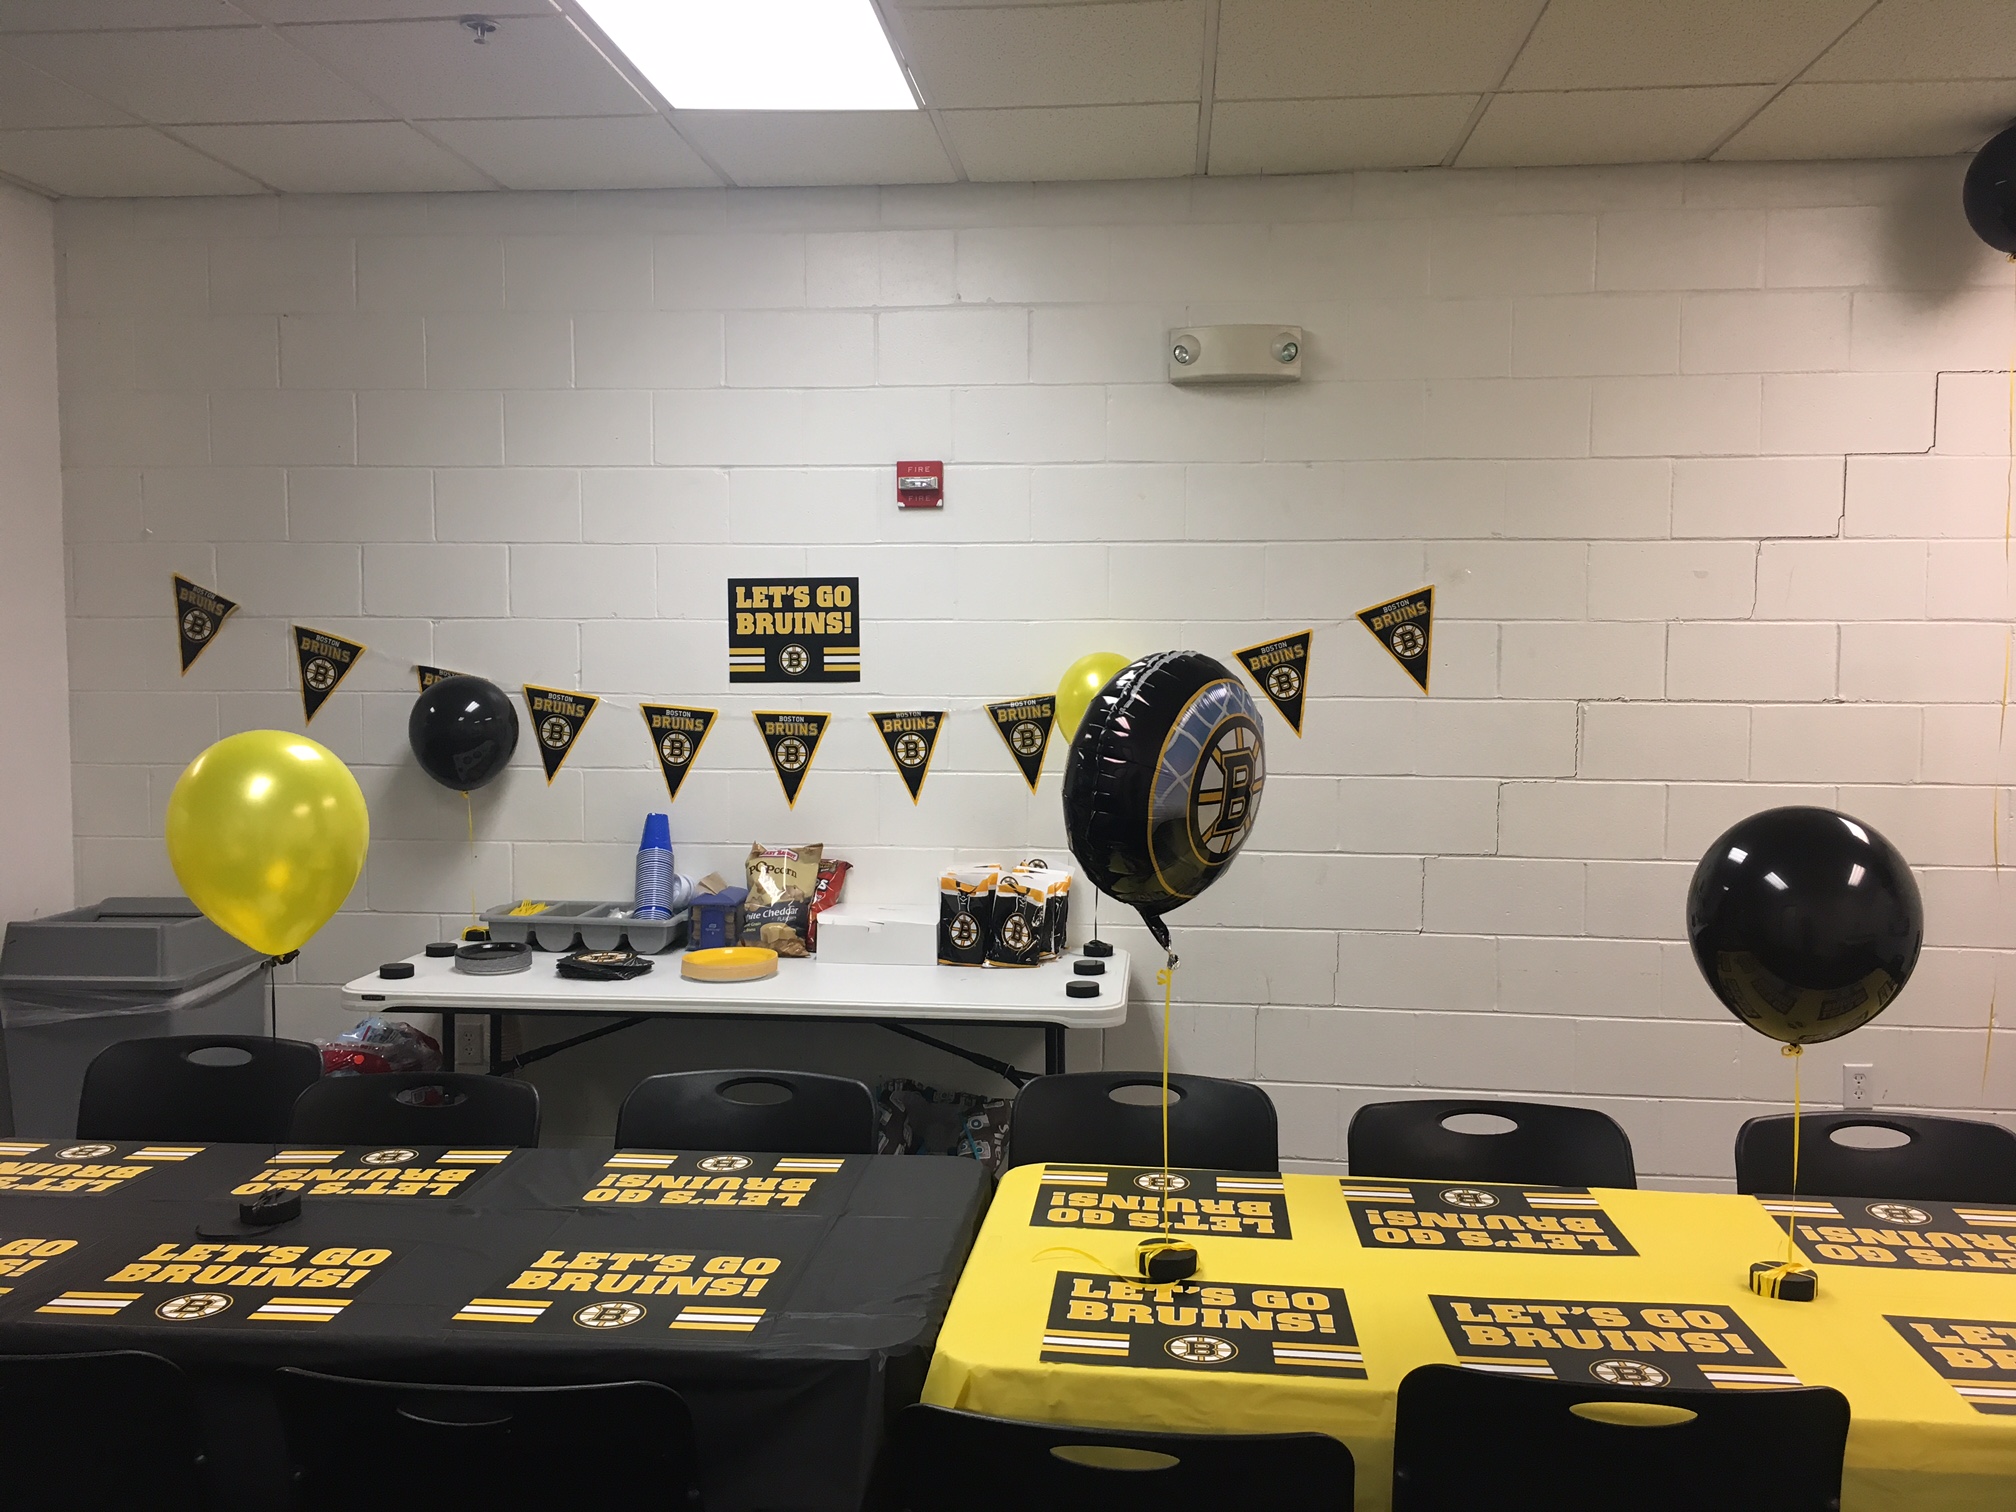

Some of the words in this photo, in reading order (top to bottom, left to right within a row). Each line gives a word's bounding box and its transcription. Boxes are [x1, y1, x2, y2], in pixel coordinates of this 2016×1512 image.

[179, 588, 225, 616] BRUINS
[192, 586, 216, 600] BOSTON
[736, 586, 811, 608] LET'S
[816, 585, 852, 608] GO
[1382, 599, 1410, 613] BOSTON
[736, 612, 852, 634] BRUINS!
[1371, 600, 1428, 632] BRUINS
[300, 637, 350, 664] BRUINS
[316, 634, 340, 648] BOSTON
[1260, 641, 1288, 654] BOSTON
[1249, 644, 1304, 672] BRUINS
[548, 692, 574, 702] BOSTON
[1010, 700, 1036, 708] BOSTON
[533, 697, 586, 718] BRUINS
[666, 710, 691, 718] BOSTON
[996, 704, 1052, 723] BRUINS
[652, 714, 704, 732] BRUINS
[765, 722, 818, 736] BRUINS
[882, 716, 936, 733] BRUINS
[1213, 748, 1256, 836] B
[763, 906, 799, 918] Cheddar
[0, 1162, 154, 1178] BRUIN
[250, 1168, 476, 1182] BRUINS!
[307, 1182, 460, 1196] LET'S
[596, 1174, 816, 1192] BRUINS!
[582, 1188, 653, 1202] GO
[659, 1190, 806, 1207] LET'S
[1050, 1192, 1272, 1216] BRUINS!
[1046, 1207, 1115, 1224] GO
[1128, 1212, 1276, 1234] LET'S
[1365, 1210, 1605, 1234] BRUINS!
[1372, 1227, 1446, 1245] GO
[1456, 1230, 1618, 1250] LET'S
[1796, 1224, 2016, 1250] RUINS!
[0, 1239, 78, 1256] GO
[138, 1244, 310, 1264] LET'S
[310, 1248, 392, 1266] GO
[1815, 1244, 1898, 1263] GO
[530, 1250, 696, 1274] LET'S
[703, 1256, 782, 1276] GO
[104, 1264, 371, 1288] BRUINS!
[506, 1270, 769, 1297] BRUINS!
[1071, 1278, 1236, 1306] LET'S
[1252, 1290, 1330, 1311] GO
[1066, 1300, 1337, 1334] BRUINS!
[1449, 1302, 1630, 1328] LET'S
[1639, 1306, 1730, 1330] GO
[1460, 1324, 1754, 1355] BRUINS!
